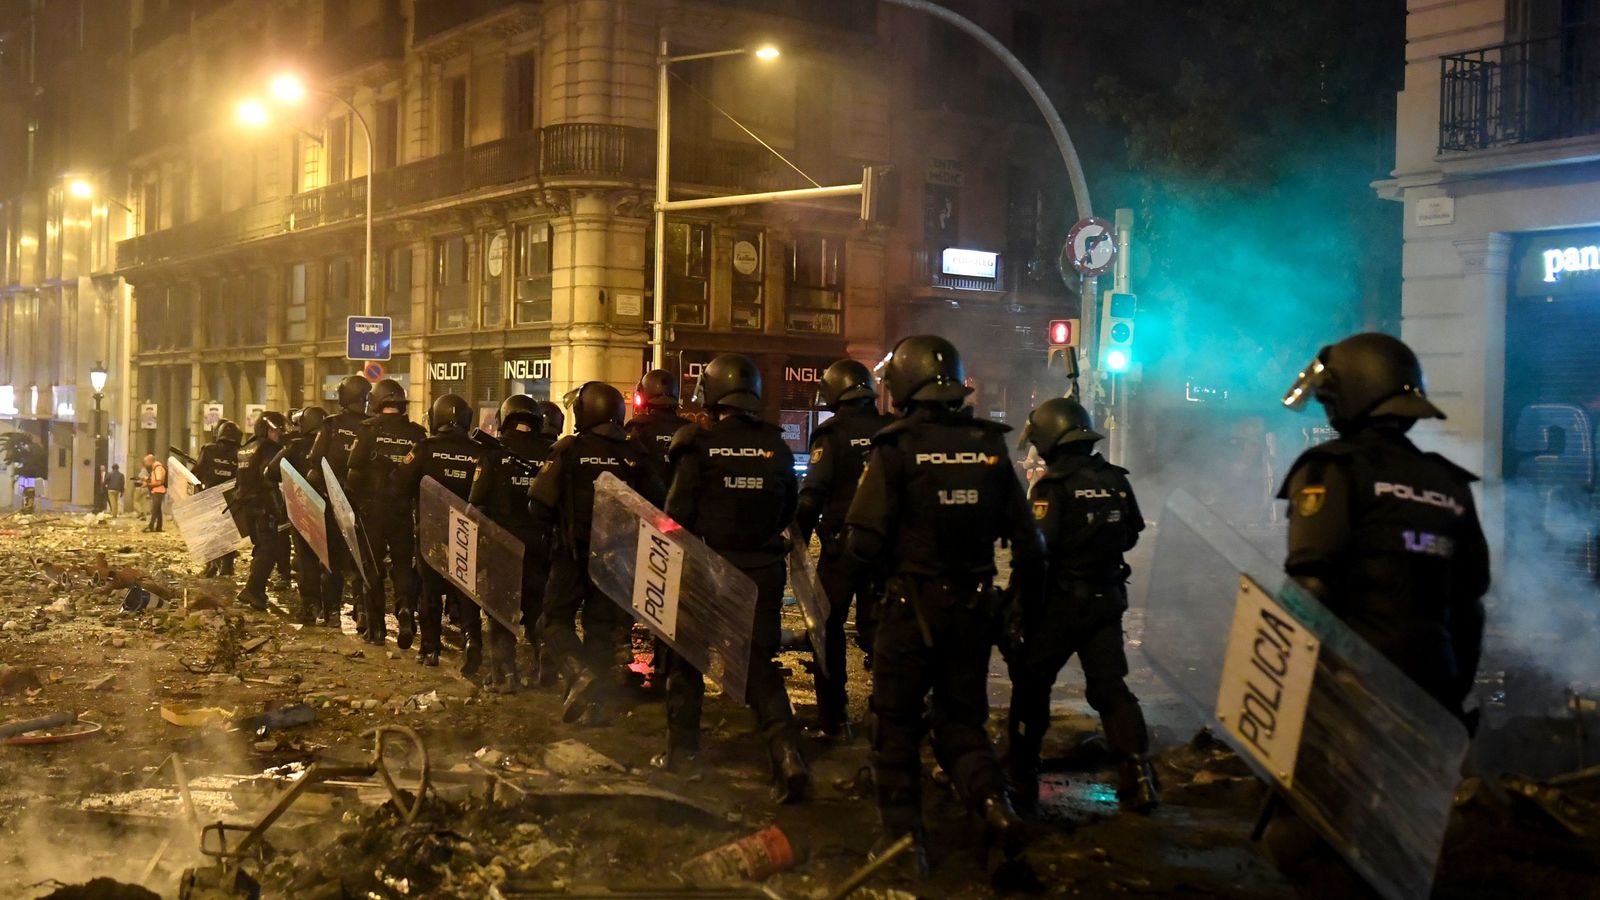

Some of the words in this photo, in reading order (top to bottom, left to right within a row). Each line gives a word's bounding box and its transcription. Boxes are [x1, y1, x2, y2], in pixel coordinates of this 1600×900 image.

[361, 343, 377, 352] taxi
[427, 362, 467, 380] INGLOT
[504, 360, 551, 379] INGLOT
[785, 367, 822, 382] INGL
[376, 436, 413, 446] POLICIA
[432, 452, 474, 462] POLICIA
[709, 447, 766, 457] POLICIA
[916, 452, 989, 464] POLICIA
[580, 457, 630, 466] POLIC
[455, 517, 470, 585] POLICIA
[645, 533, 670, 625] POLICIA
[1238, 608, 1296, 759] POLICIA
